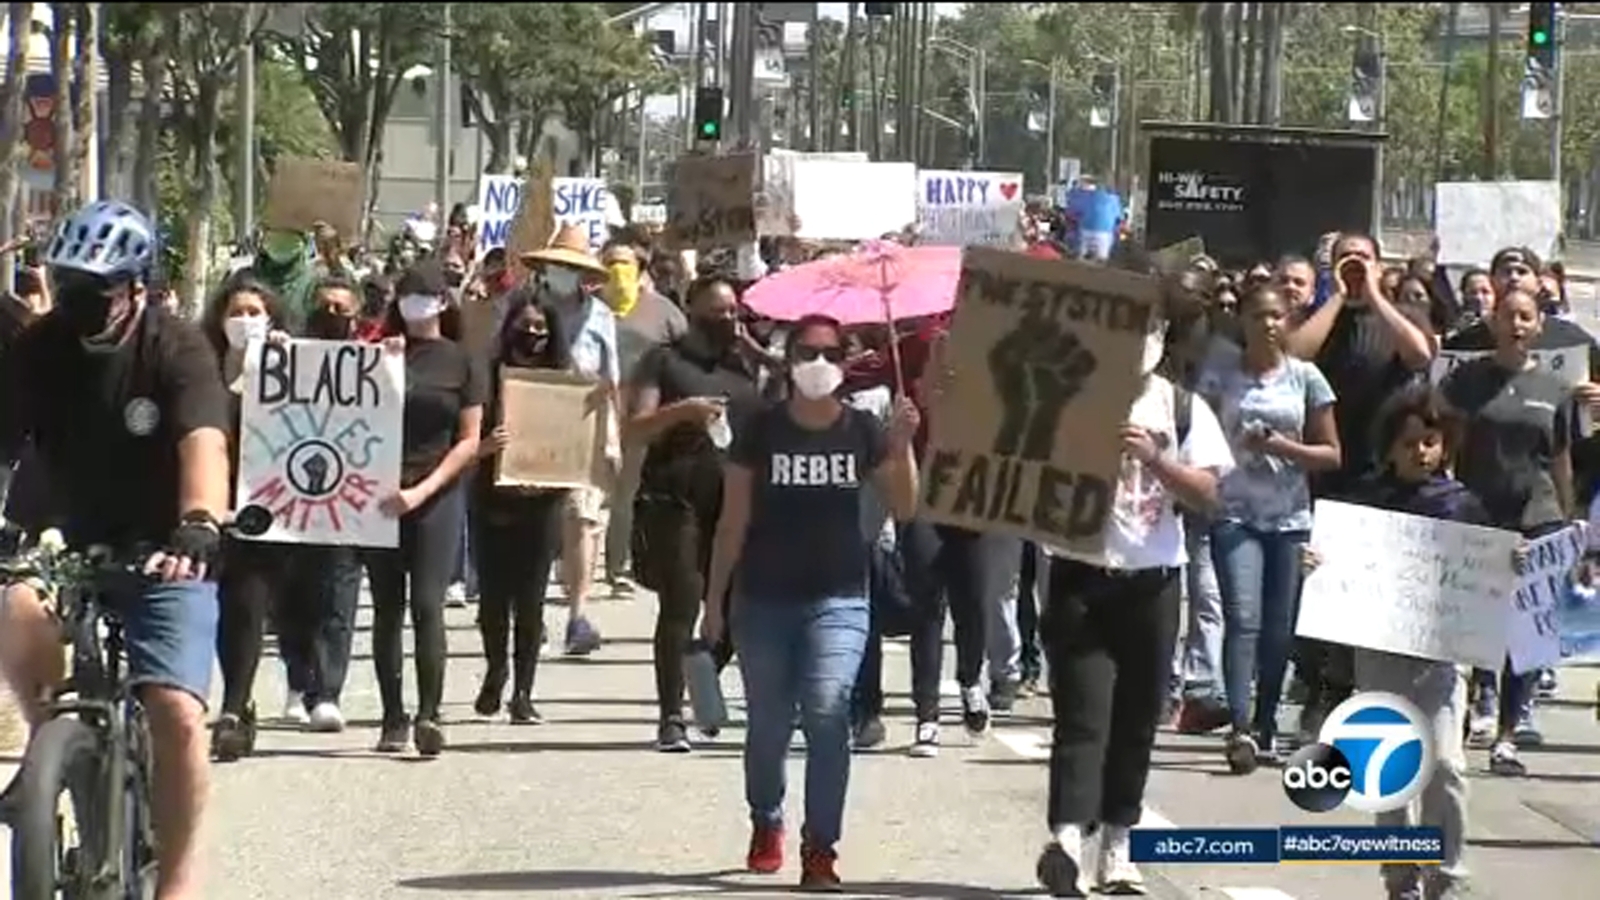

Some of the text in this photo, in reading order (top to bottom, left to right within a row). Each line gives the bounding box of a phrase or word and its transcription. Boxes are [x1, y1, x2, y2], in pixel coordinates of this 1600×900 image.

[485, 181, 518, 214] NO
[926, 177, 989, 205] HAPPY
[1174, 175, 1243, 201] SAFETY
[1020, 280, 1151, 333] SYSTEM
[259, 343, 380, 406] BLACK
[246, 402, 383, 468] LIVES
[771, 453, 858, 488] REBEL
[925, 452, 1110, 537] FAILED
[250, 472, 379, 530] MATTER
